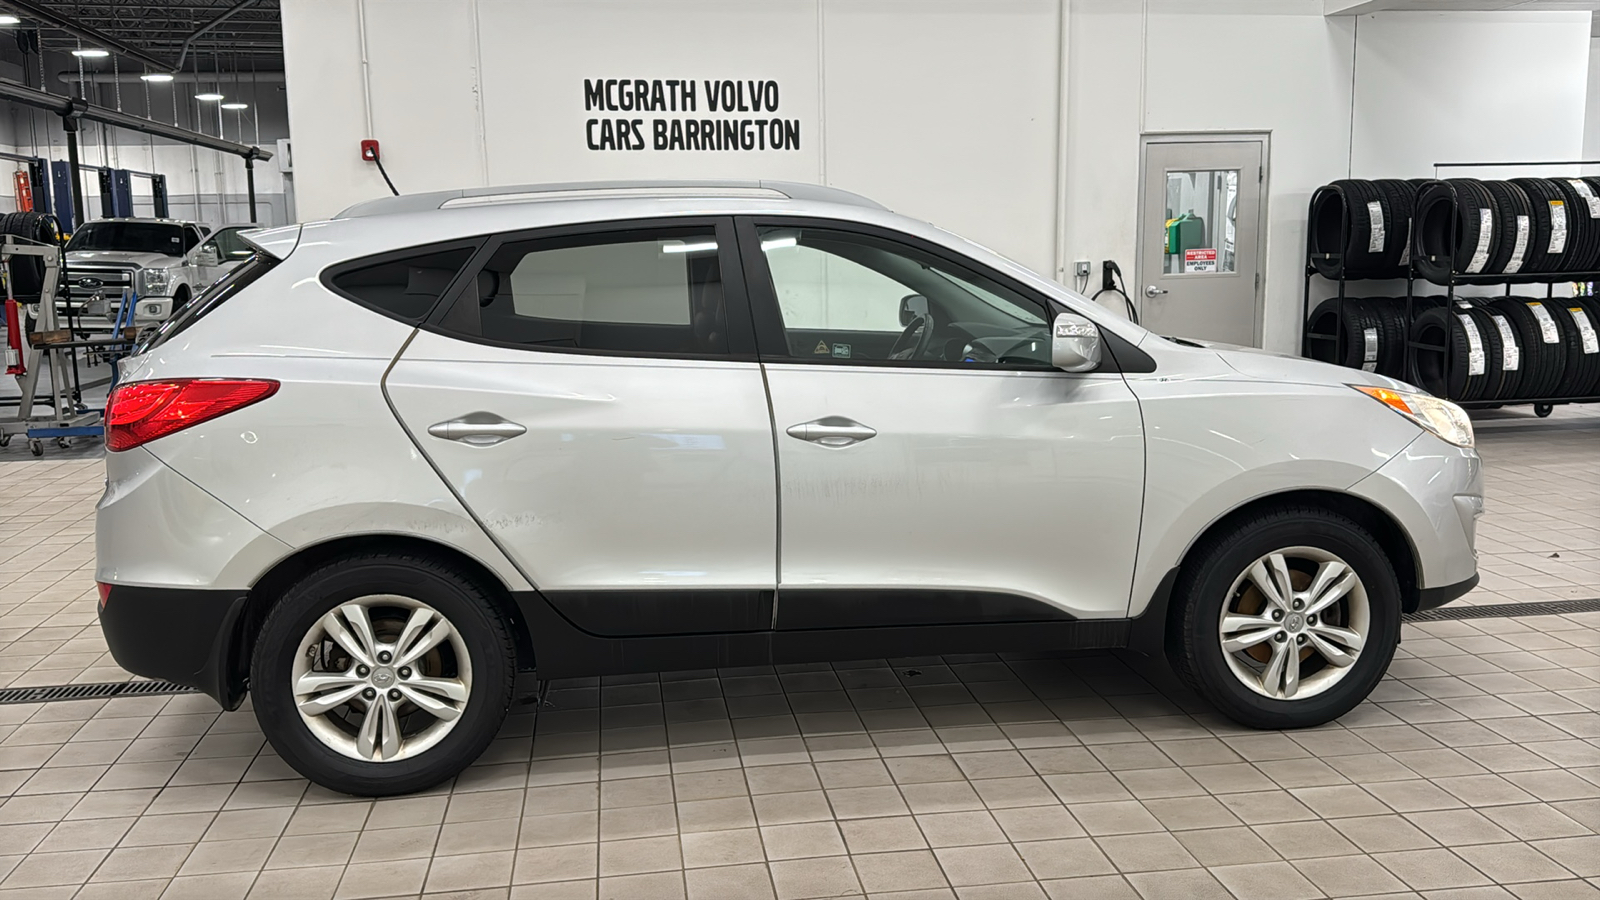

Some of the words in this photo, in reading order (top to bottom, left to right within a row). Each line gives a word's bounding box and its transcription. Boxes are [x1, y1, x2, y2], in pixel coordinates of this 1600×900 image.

[584, 79, 696, 111] MCGRATH
[704, 80, 779, 112] VOLVO
[586, 118, 645, 150] CARS
[653, 118, 800, 150] BARRINGTON
